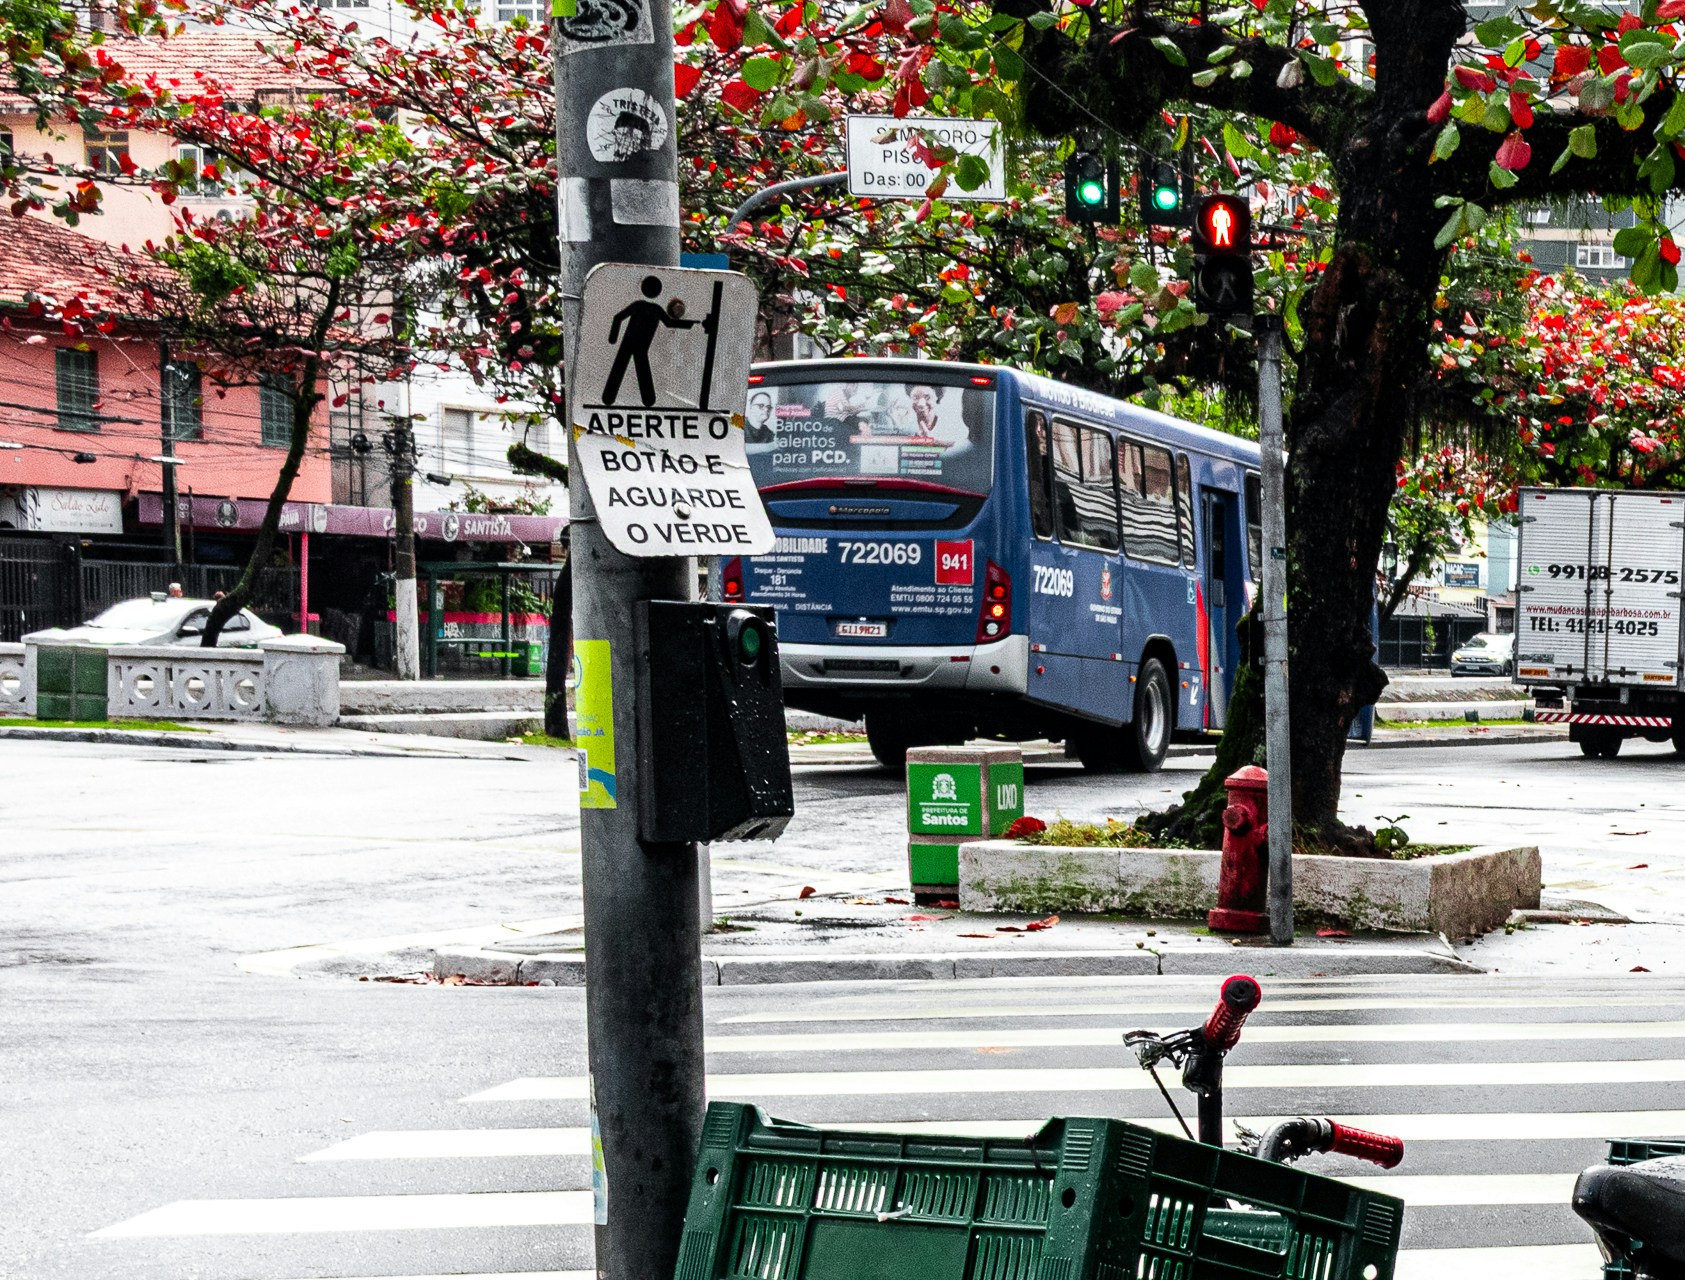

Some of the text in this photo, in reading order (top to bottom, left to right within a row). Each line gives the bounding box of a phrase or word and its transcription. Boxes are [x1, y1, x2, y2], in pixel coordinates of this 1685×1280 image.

[863, 171, 900, 187] Das:
[905, 172, 926, 188] 00
[586, 412, 729, 440] APERTE O
[775, 419, 822, 433] Banco
[773, 434, 837, 449] talentos
[600, 448, 725, 475] BOTÃO E
[772, 449, 850, 467] para PCD.
[608, 486, 746, 510] AGUARDE
[464, 520, 512, 536] SANTISTA
[626, 523, 753, 545] O VERDE
[837, 542, 922, 565] 722069
[941, 553, 968, 570] 941
[770, 574, 787, 586] 181
[1032, 564, 1074, 598] 722069
[1547, 564, 1679, 585] 99128-2575
[891, 585, 936, 593] Atendimento
[948, 586, 974, 594] Cliente
[890, 594, 914, 602] EMTU
[915, 594, 935, 603] 0800
[936, 595, 951, 603] 724
[890, 605, 974, 615] www.emtu.sp.gov.br
[1529, 616, 1560, 632] TEL:
[997, 783, 1018, 811] LIXO
[921, 813, 969, 827] Santos
